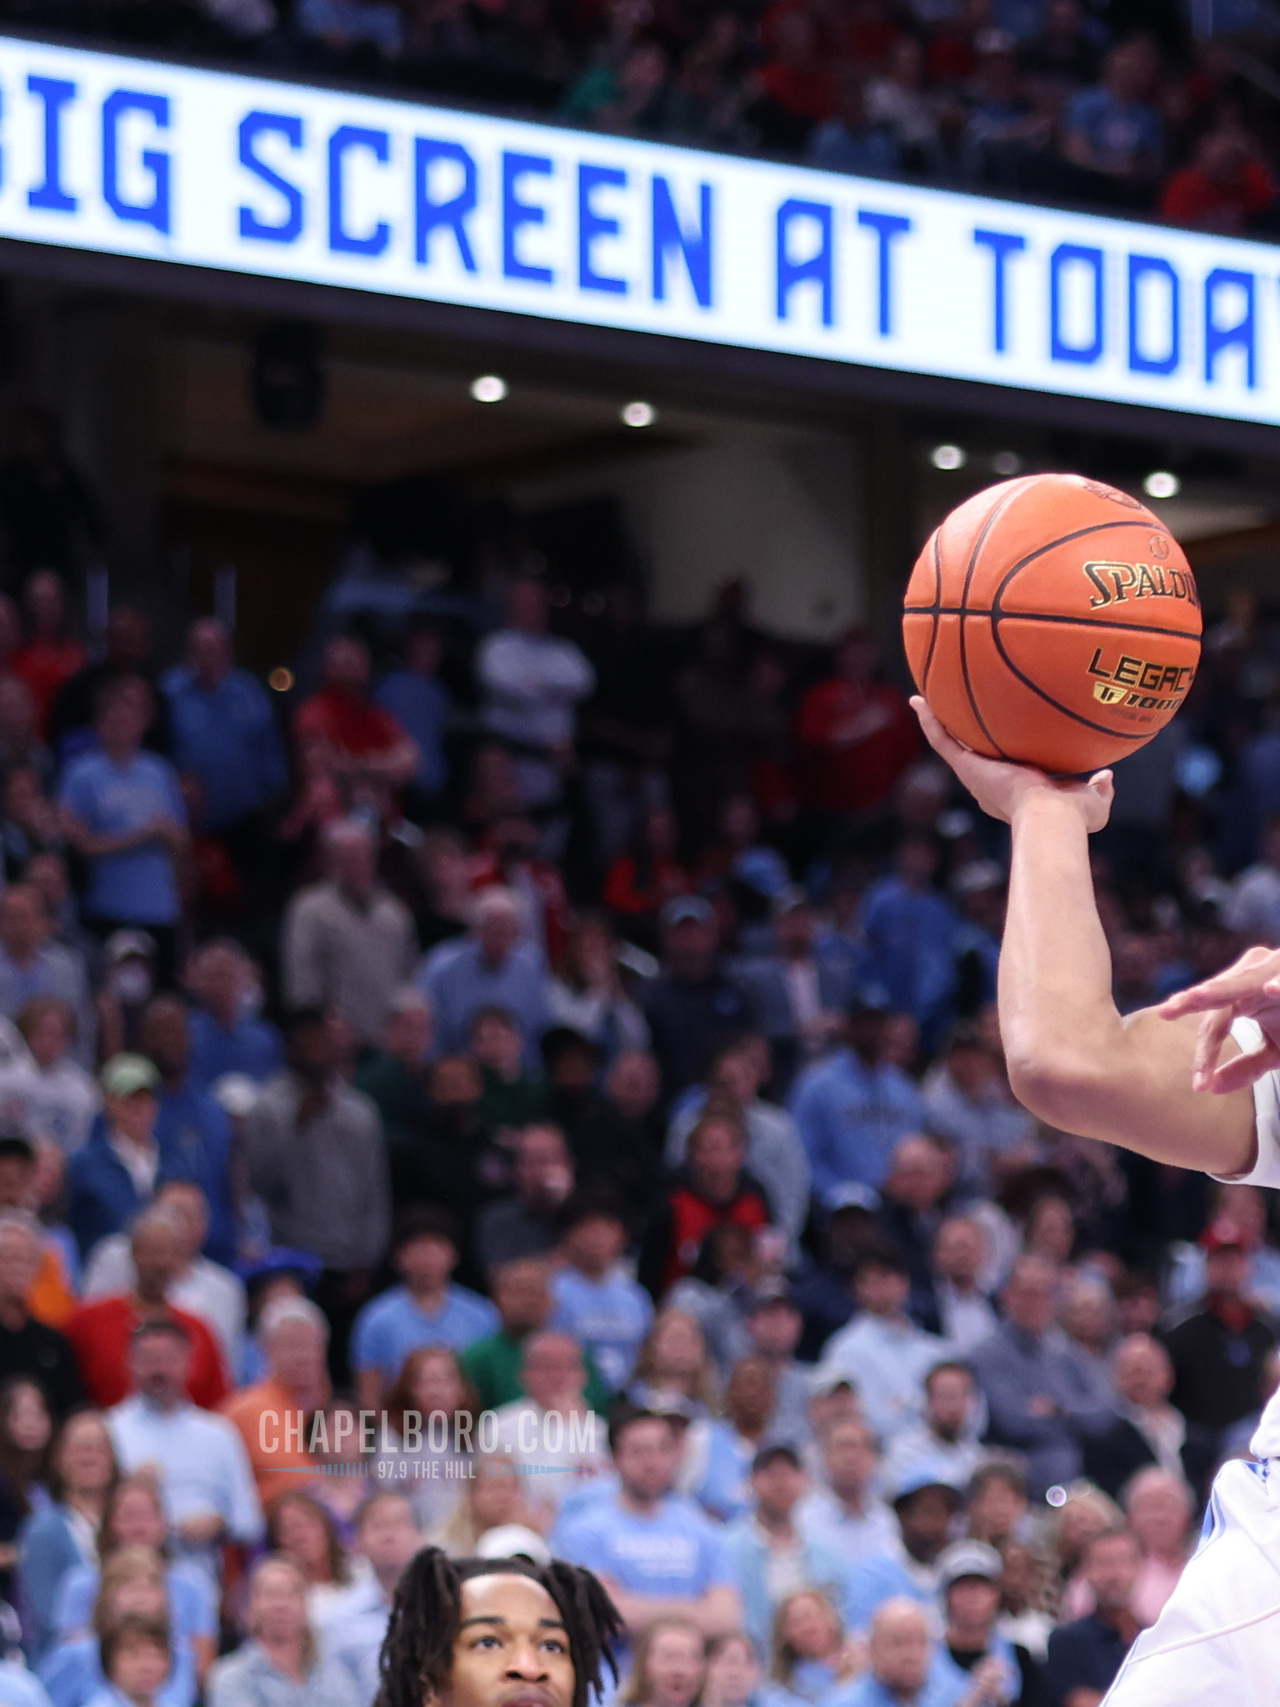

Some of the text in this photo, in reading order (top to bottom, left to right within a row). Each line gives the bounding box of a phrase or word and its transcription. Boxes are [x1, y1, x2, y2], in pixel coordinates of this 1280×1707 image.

[0, 73, 172, 237] IG
[238, 107, 713, 309] SCREEN
[775, 198, 911, 337] AT
